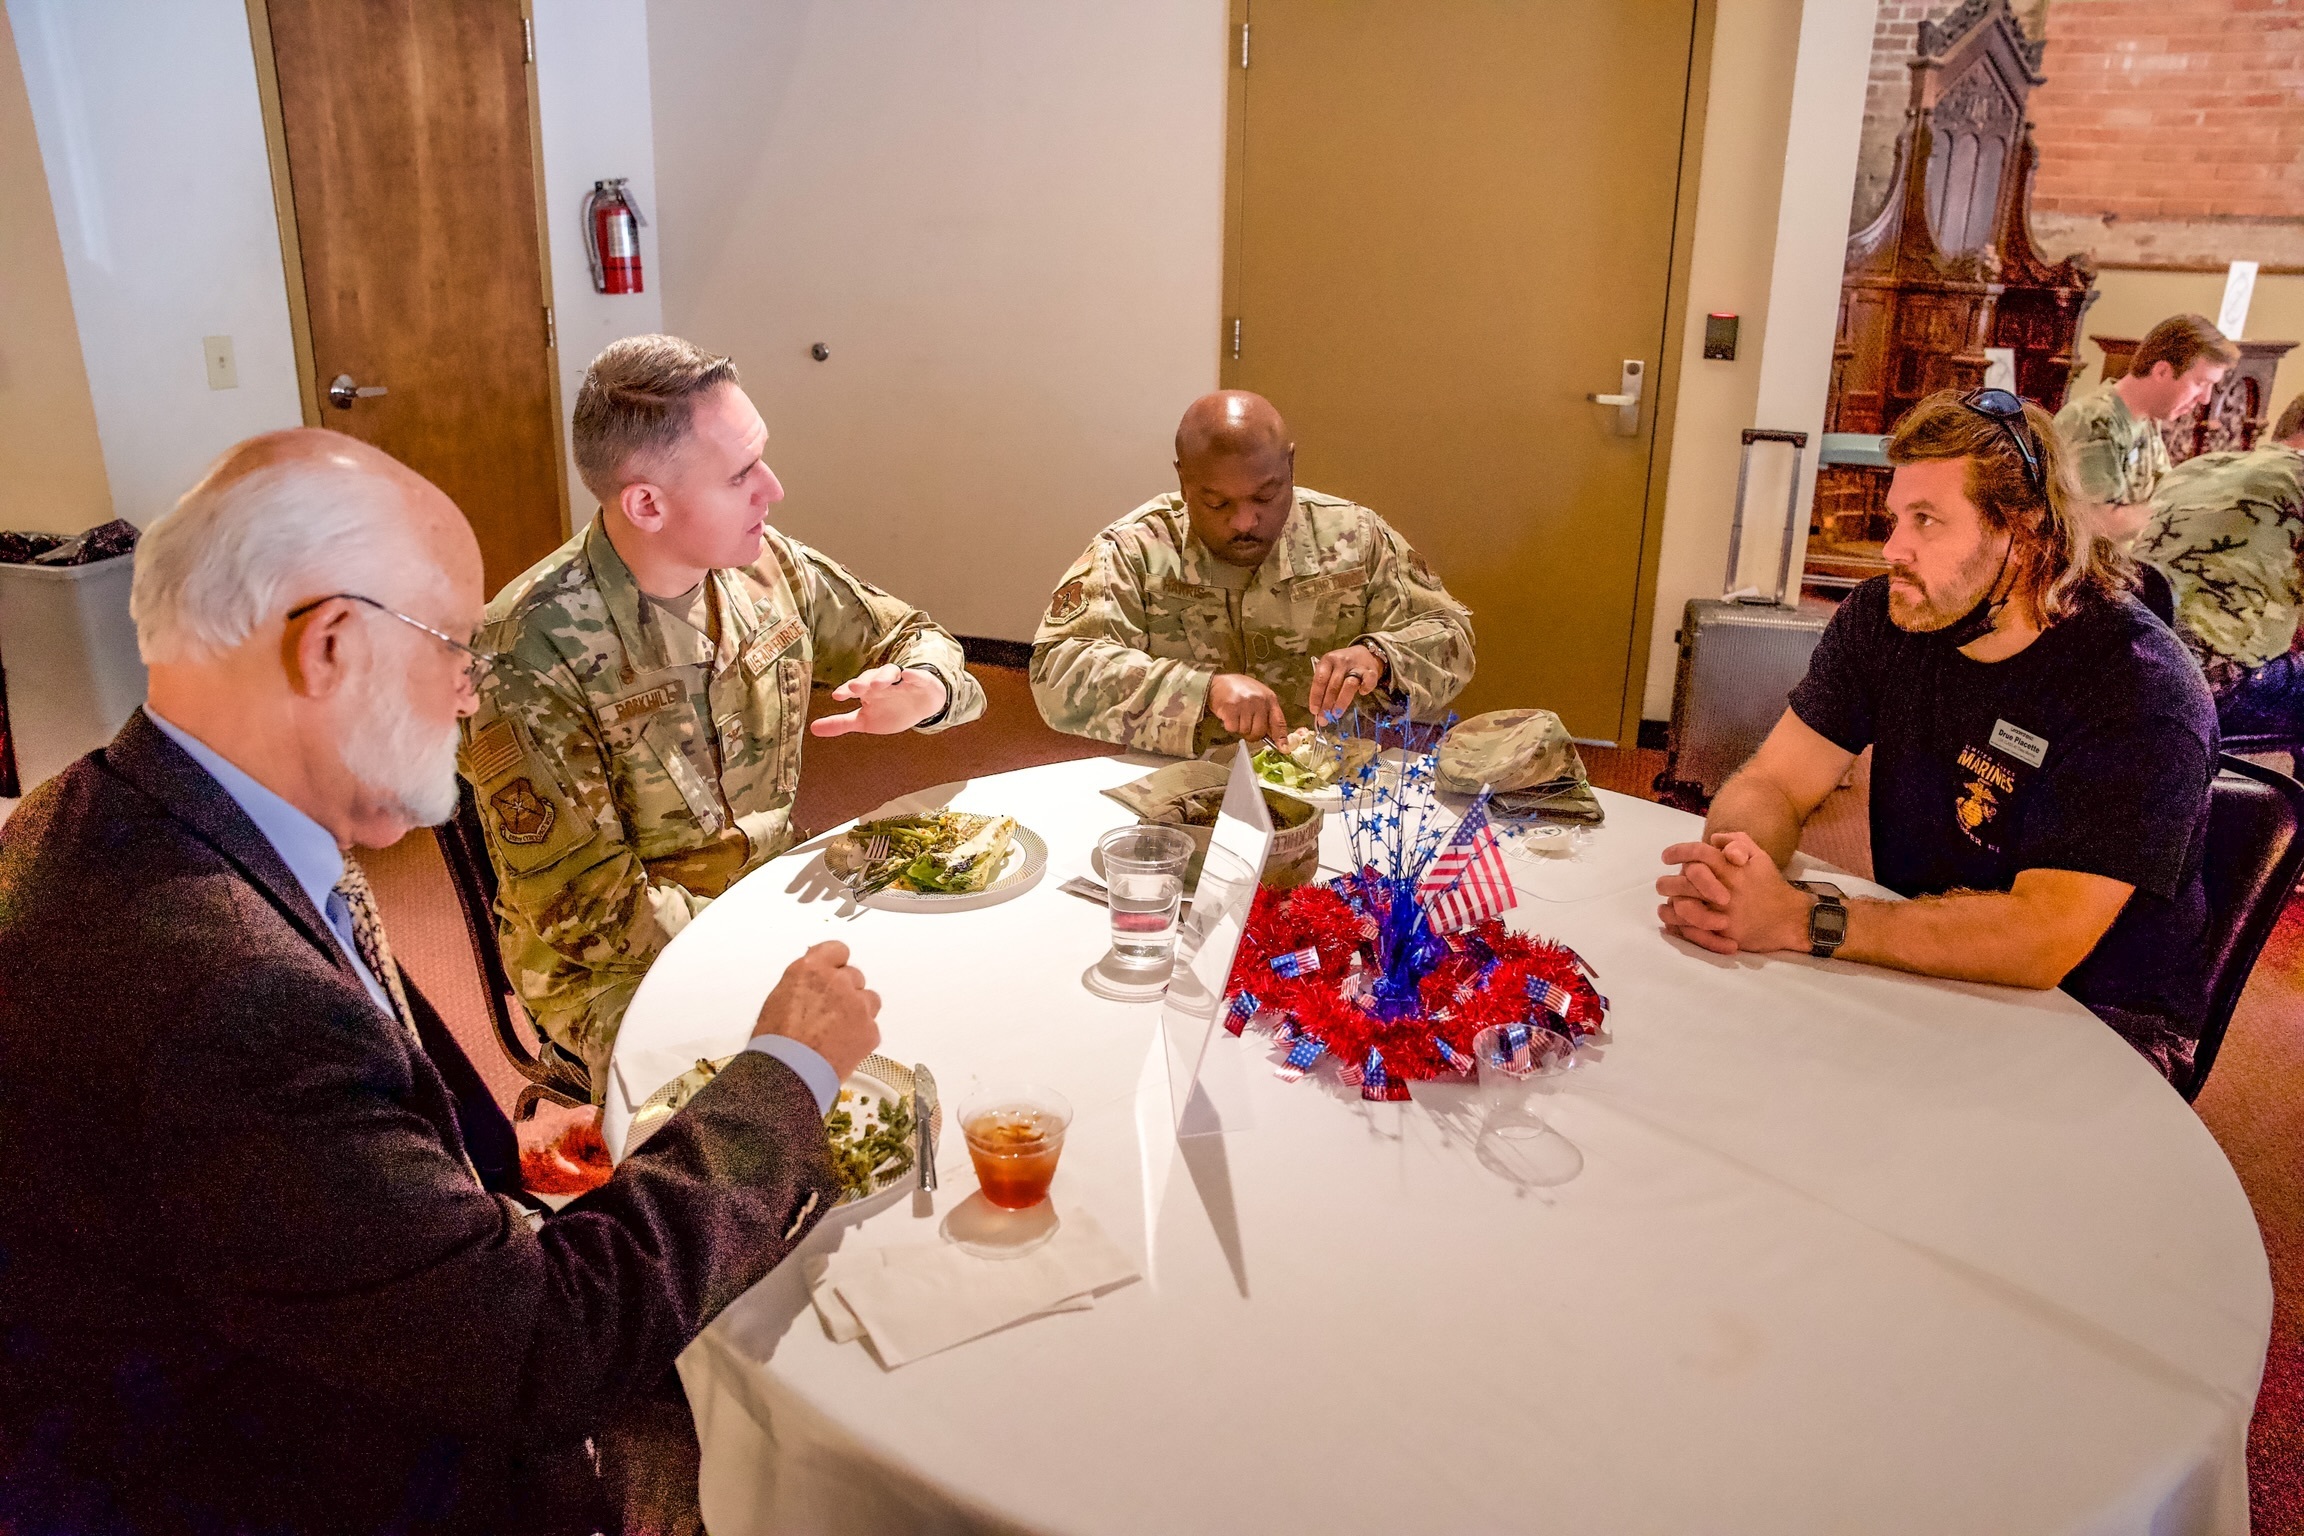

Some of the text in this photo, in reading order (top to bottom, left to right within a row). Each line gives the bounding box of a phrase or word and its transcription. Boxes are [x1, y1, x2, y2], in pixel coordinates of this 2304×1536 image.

[1162, 579, 1204, 599] HARRIS
[756, 641, 777, 663] AIR
[769, 619, 805, 652] FORCE
[614, 686, 675, 722] PARKHILL
[1998, 729, 2014, 741] Drue
[2013, 736, 2040, 754] Placette
[1957, 750, 2013, 793] MARINES
